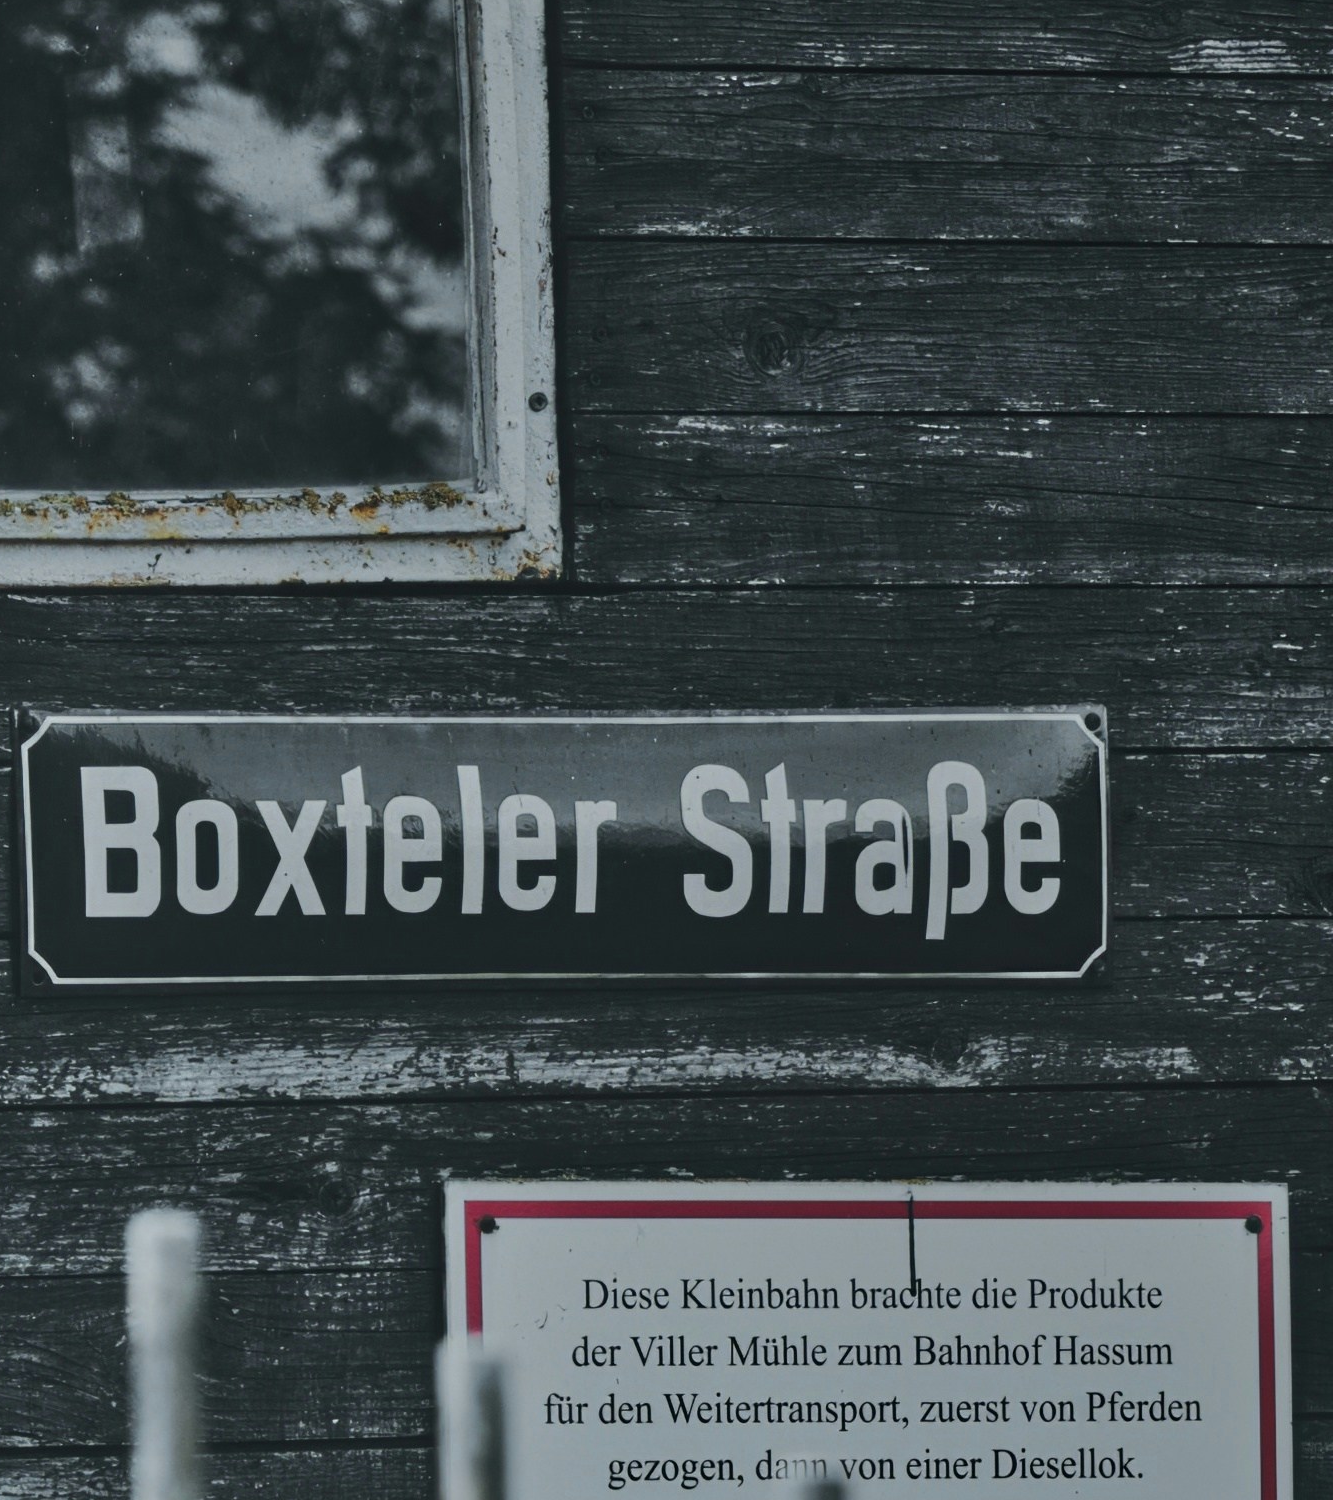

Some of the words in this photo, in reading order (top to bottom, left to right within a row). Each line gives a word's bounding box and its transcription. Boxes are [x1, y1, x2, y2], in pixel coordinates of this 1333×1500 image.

[80, 764, 617, 918] Boxteler
[682, 760, 1061, 941] Straße
[582, 1276, 670, 1310] Diese
[679, 1276, 840, 1310] Kleinbahn
[849, 1276, 962, 1310] brachte
[970, 1276, 1018, 1310] die
[1027, 1276, 1163, 1310] Produkte
[571, 1334, 621, 1367] der
[629, 1334, 718, 1367] Viller
[728, 1334, 828, 1367] Mühle
[837, 1342, 903, 1366] zum
[912, 1333, 1047, 1366] Bahnhof
[1052, 1334, 1174, 1366] Hassum
[543, 1391, 589, 1425] für
[598, 1392, 654, 1425] den
[664, 1391, 911, 1431] Weitertransport,
[919, 1394, 1011, 1423] zuerst
[1019, 1400, 1077, 1423] von
[1085, 1390, 1203, 1423] Pferden
[607, 1454, 746, 1490] gezogen,
[754, 1447, 829, 1480] dann
[839, 1455, 896, 1480] von
[905, 1447, 983, 1480] einer
[991, 1446, 1145, 1480] Diesellok.
